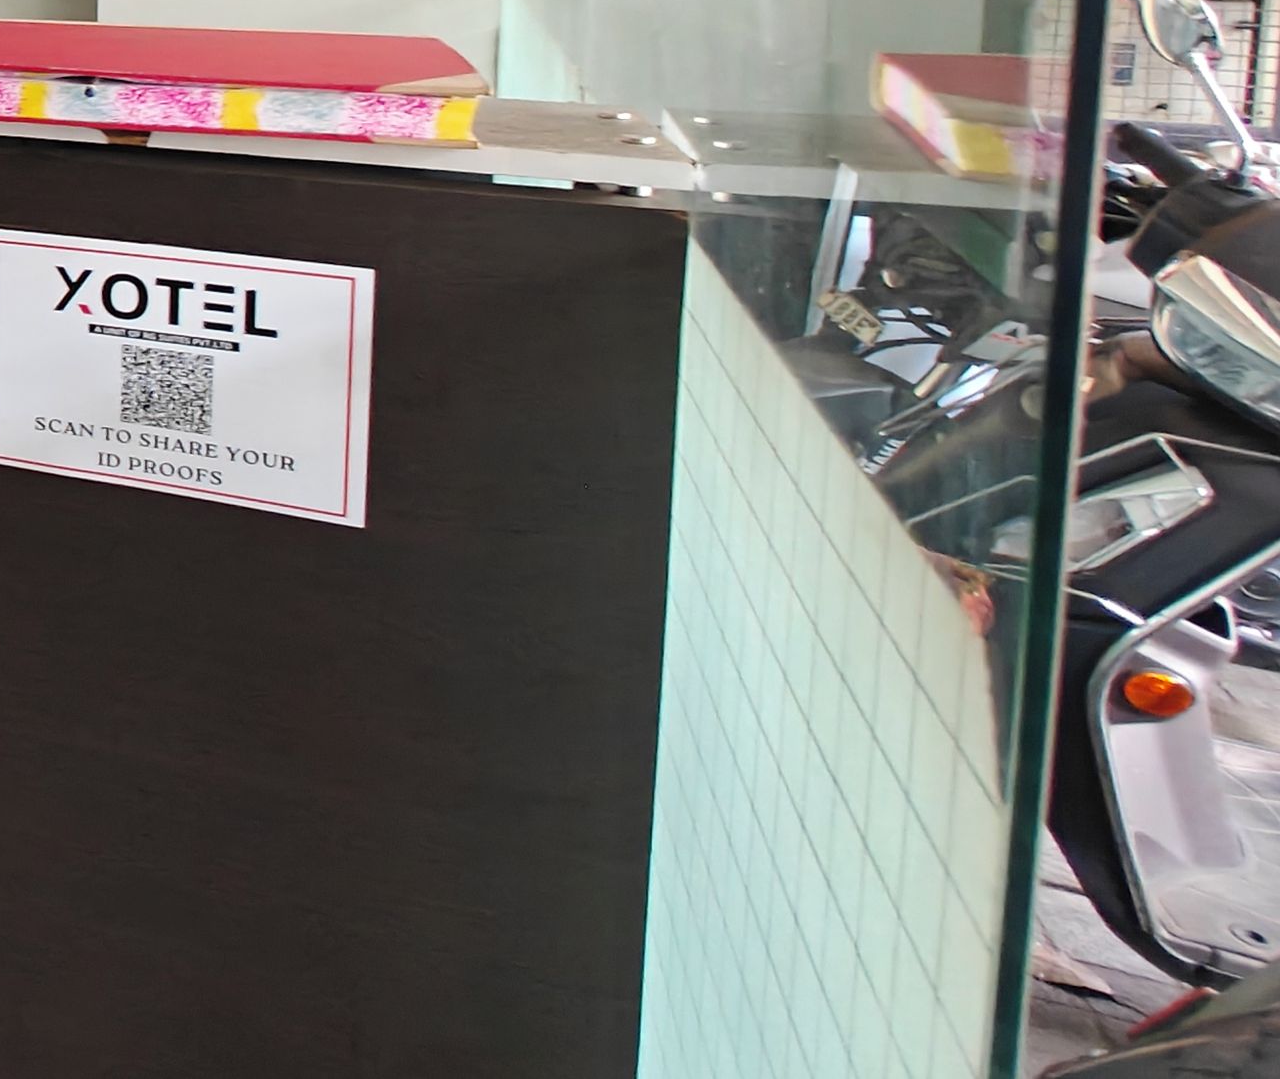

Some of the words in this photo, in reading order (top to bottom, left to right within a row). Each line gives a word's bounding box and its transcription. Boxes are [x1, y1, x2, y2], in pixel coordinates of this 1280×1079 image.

[53, 265, 278, 338] XOTEL
[33, 416, 94, 438] SCAN
[101, 426, 132, 444] TO
[139, 433, 219, 459] SHARE
[225, 446, 296, 472] YOUR
[97, 451, 121, 468] ID
[128, 456, 223, 486] PROOFS
